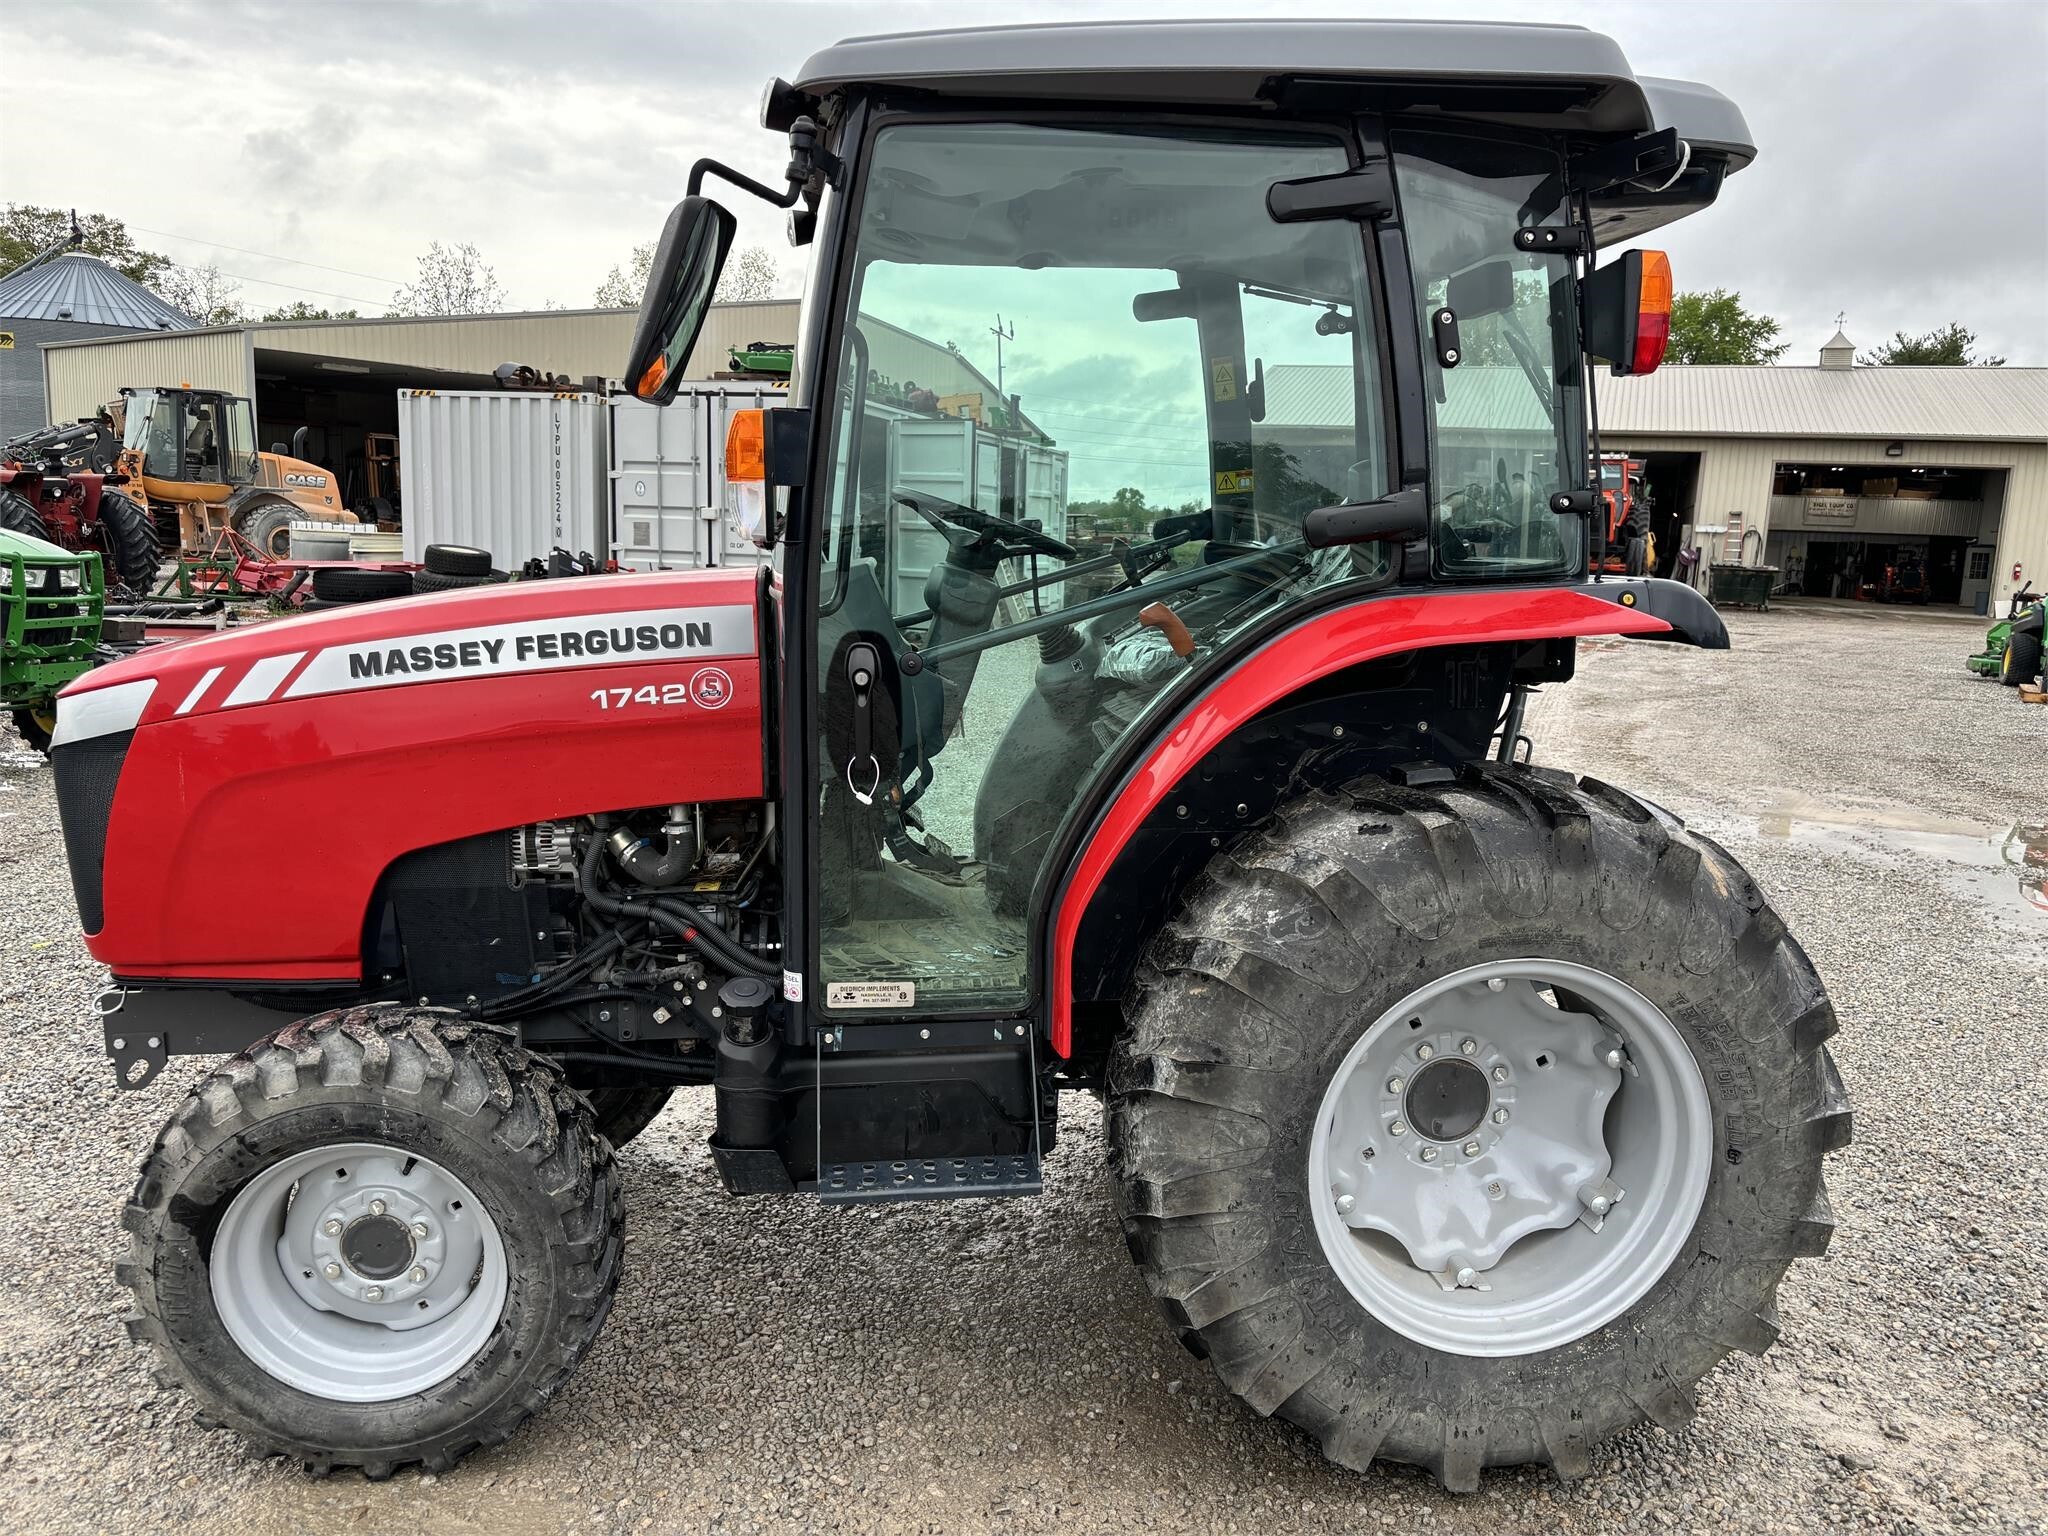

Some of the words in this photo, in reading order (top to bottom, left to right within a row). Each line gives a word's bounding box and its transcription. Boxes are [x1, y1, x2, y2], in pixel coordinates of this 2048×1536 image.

[284, 474, 327, 488] CASE
[349, 637, 505, 679] MASSEY
[516, 621, 712, 662] FERGUSON
[590, 684, 687, 710] 1742
[1667, 990, 1738, 1101] TRACTOR
[1725, 1113, 1744, 1165] LUG
[1696, 994, 1763, 1145] INDUSTRIAL
[1274, 1190, 1360, 1346] TITAN
